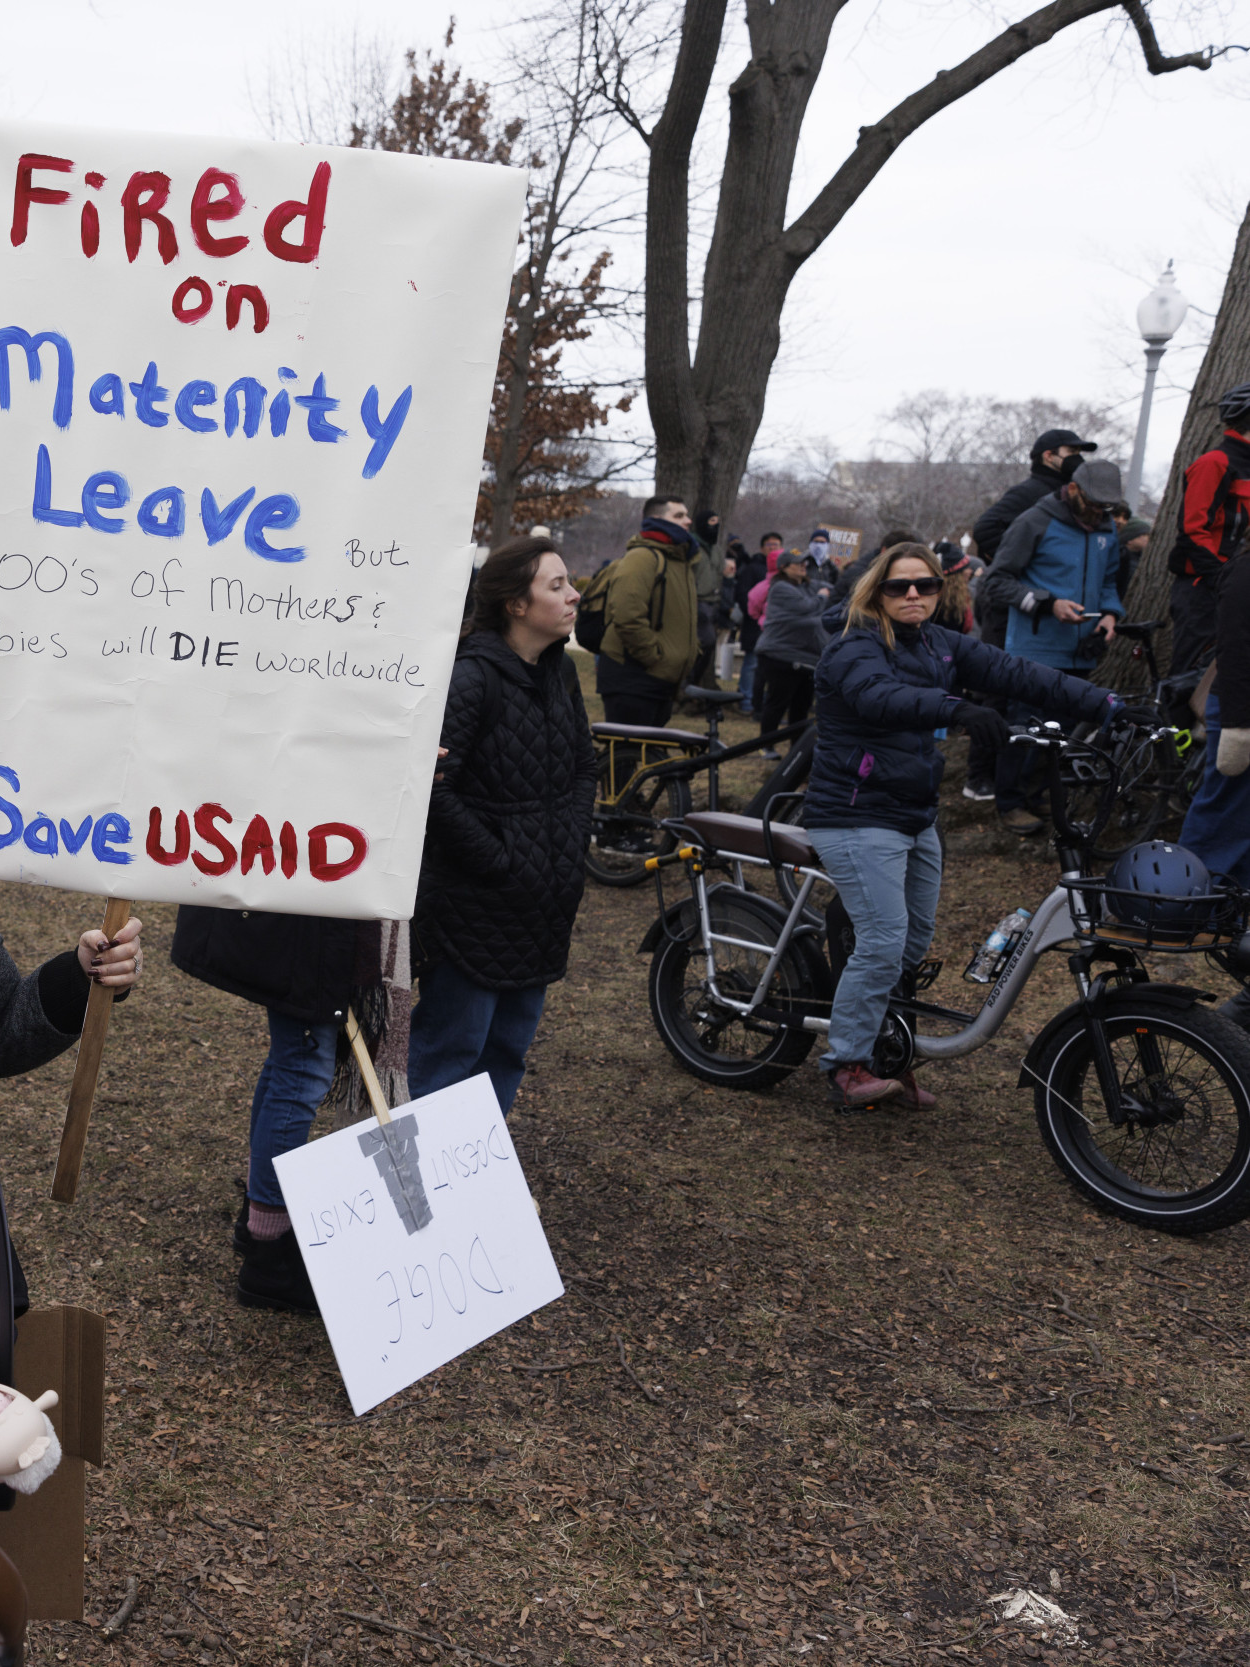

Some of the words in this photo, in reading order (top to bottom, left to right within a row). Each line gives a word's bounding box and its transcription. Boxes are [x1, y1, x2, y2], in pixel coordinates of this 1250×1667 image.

[171, 276, 270, 334] on
[32, 443, 307, 564] Leave
[130, 558, 186, 604] of
[344, 538, 410, 568] But
[101, 625, 158, 657] will
[168, 631, 240, 668] DIE
[986, 989, 1001, 1008] RAD
[998, 956, 1020, 990] POWER
[1015, 930, 1034, 957] BIKES
[308, 1188, 377, 1248] EXIST
